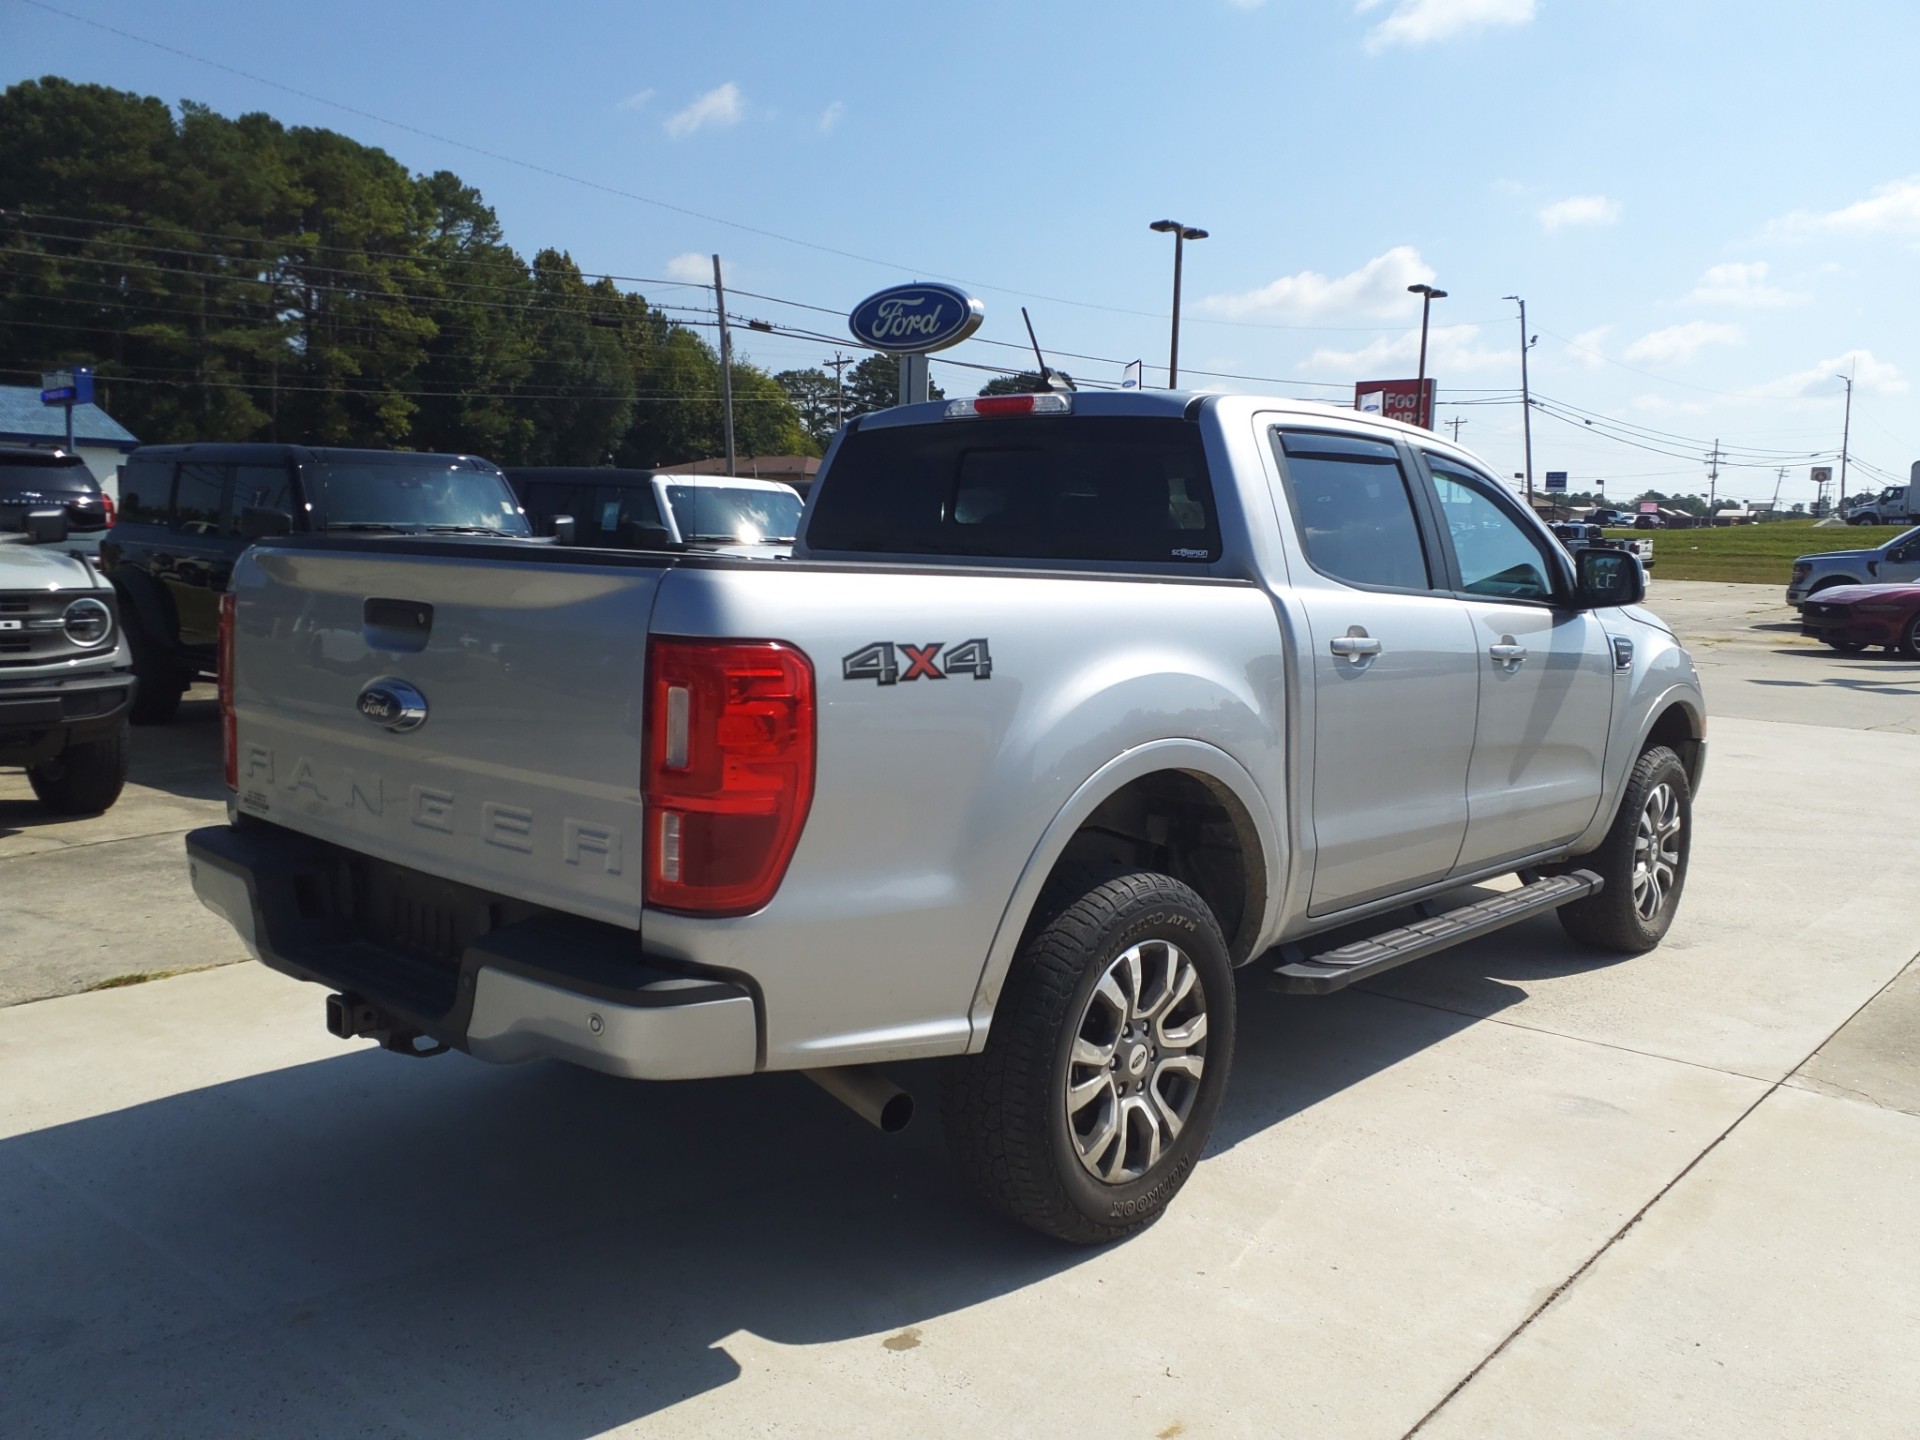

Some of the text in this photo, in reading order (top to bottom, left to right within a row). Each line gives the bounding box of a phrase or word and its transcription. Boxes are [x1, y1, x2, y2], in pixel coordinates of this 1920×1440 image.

[871, 296, 941, 338] Ford
[362, 691, 391, 718] Ford
[244, 742, 623, 877] RANGER
